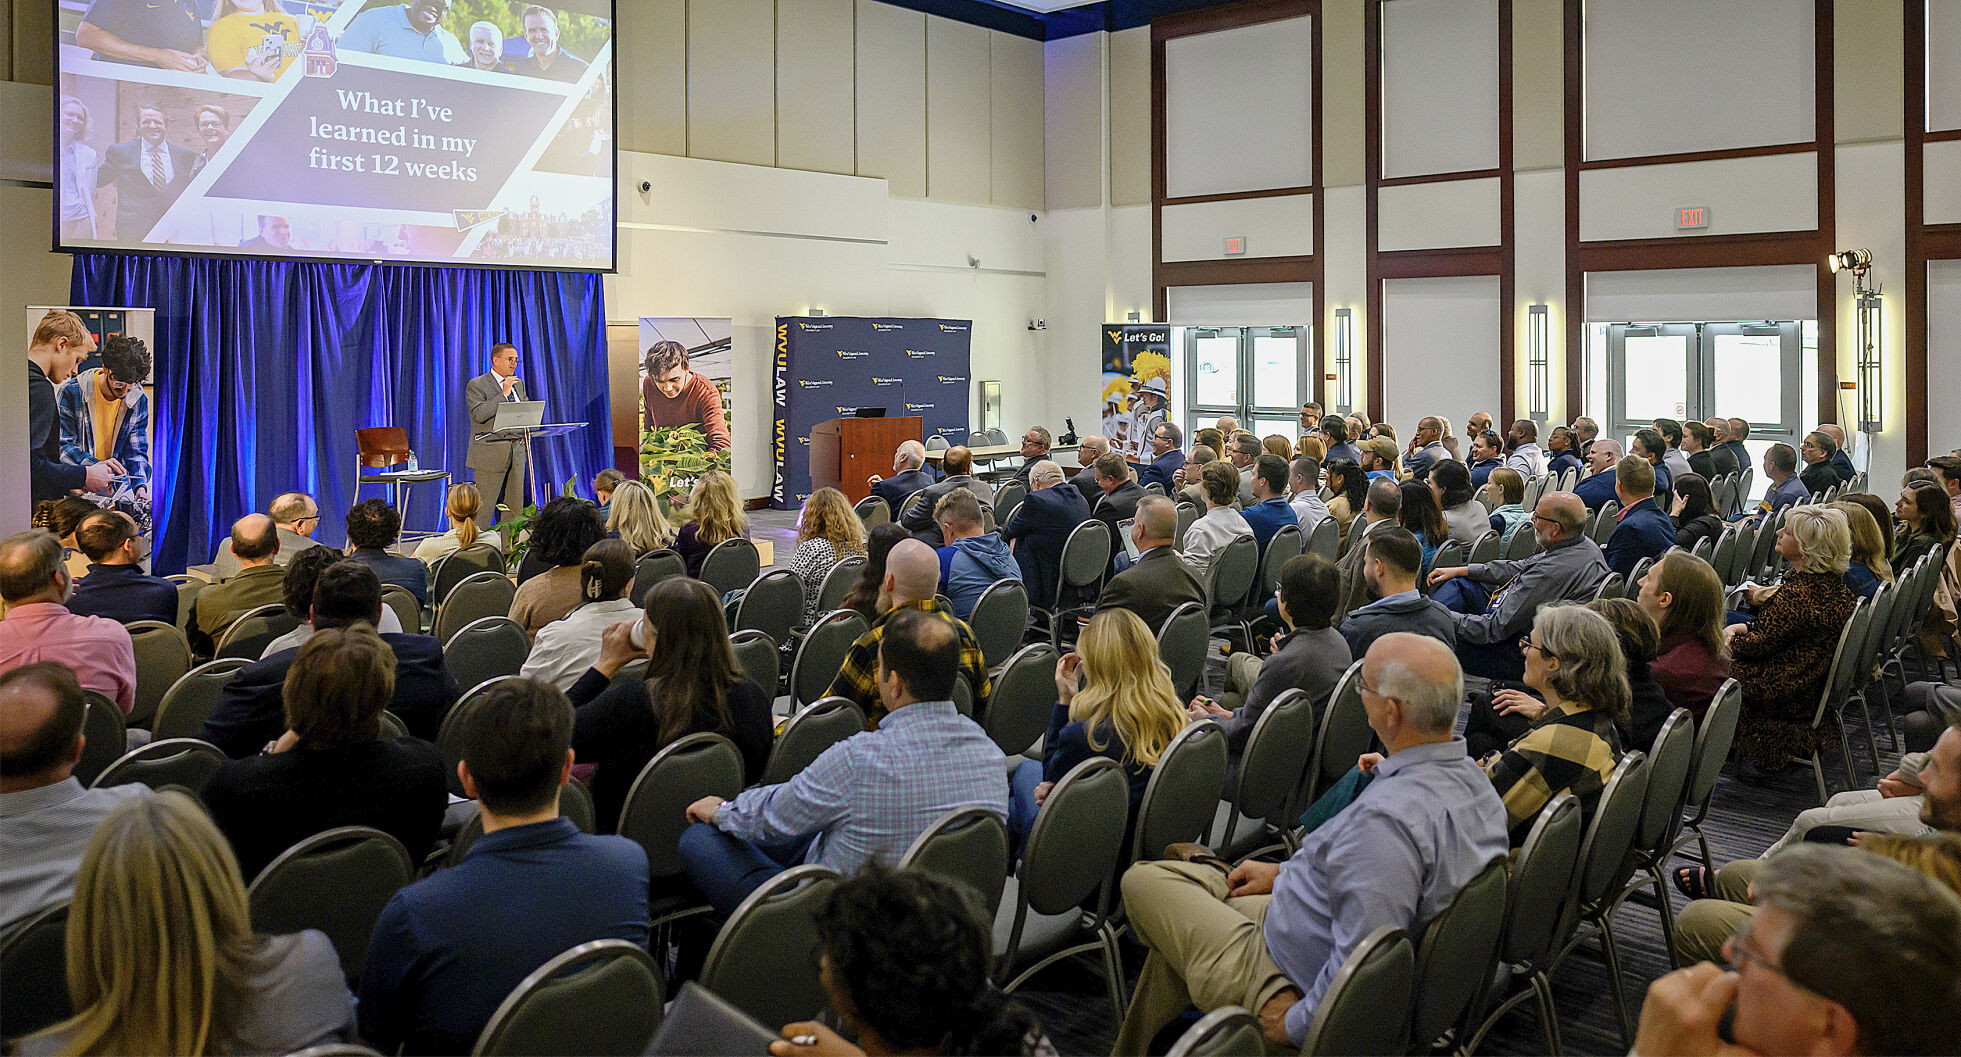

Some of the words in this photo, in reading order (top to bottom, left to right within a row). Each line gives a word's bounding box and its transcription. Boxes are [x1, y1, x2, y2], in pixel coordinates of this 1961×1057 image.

[336, 89, 405, 117] What
[410, 98, 453, 123] I’ve
[309, 116, 407, 147] learned
[412, 128, 436, 150] in
[441, 137, 478, 158] my
[308, 146, 366, 173] first
[371, 153, 400, 176] 12
[404, 160, 478, 182] weeks
[1681, 208, 1704, 226] EXIT
[1124, 332, 1148, 342] Let's
[1149, 332, 1165, 342] Go!
